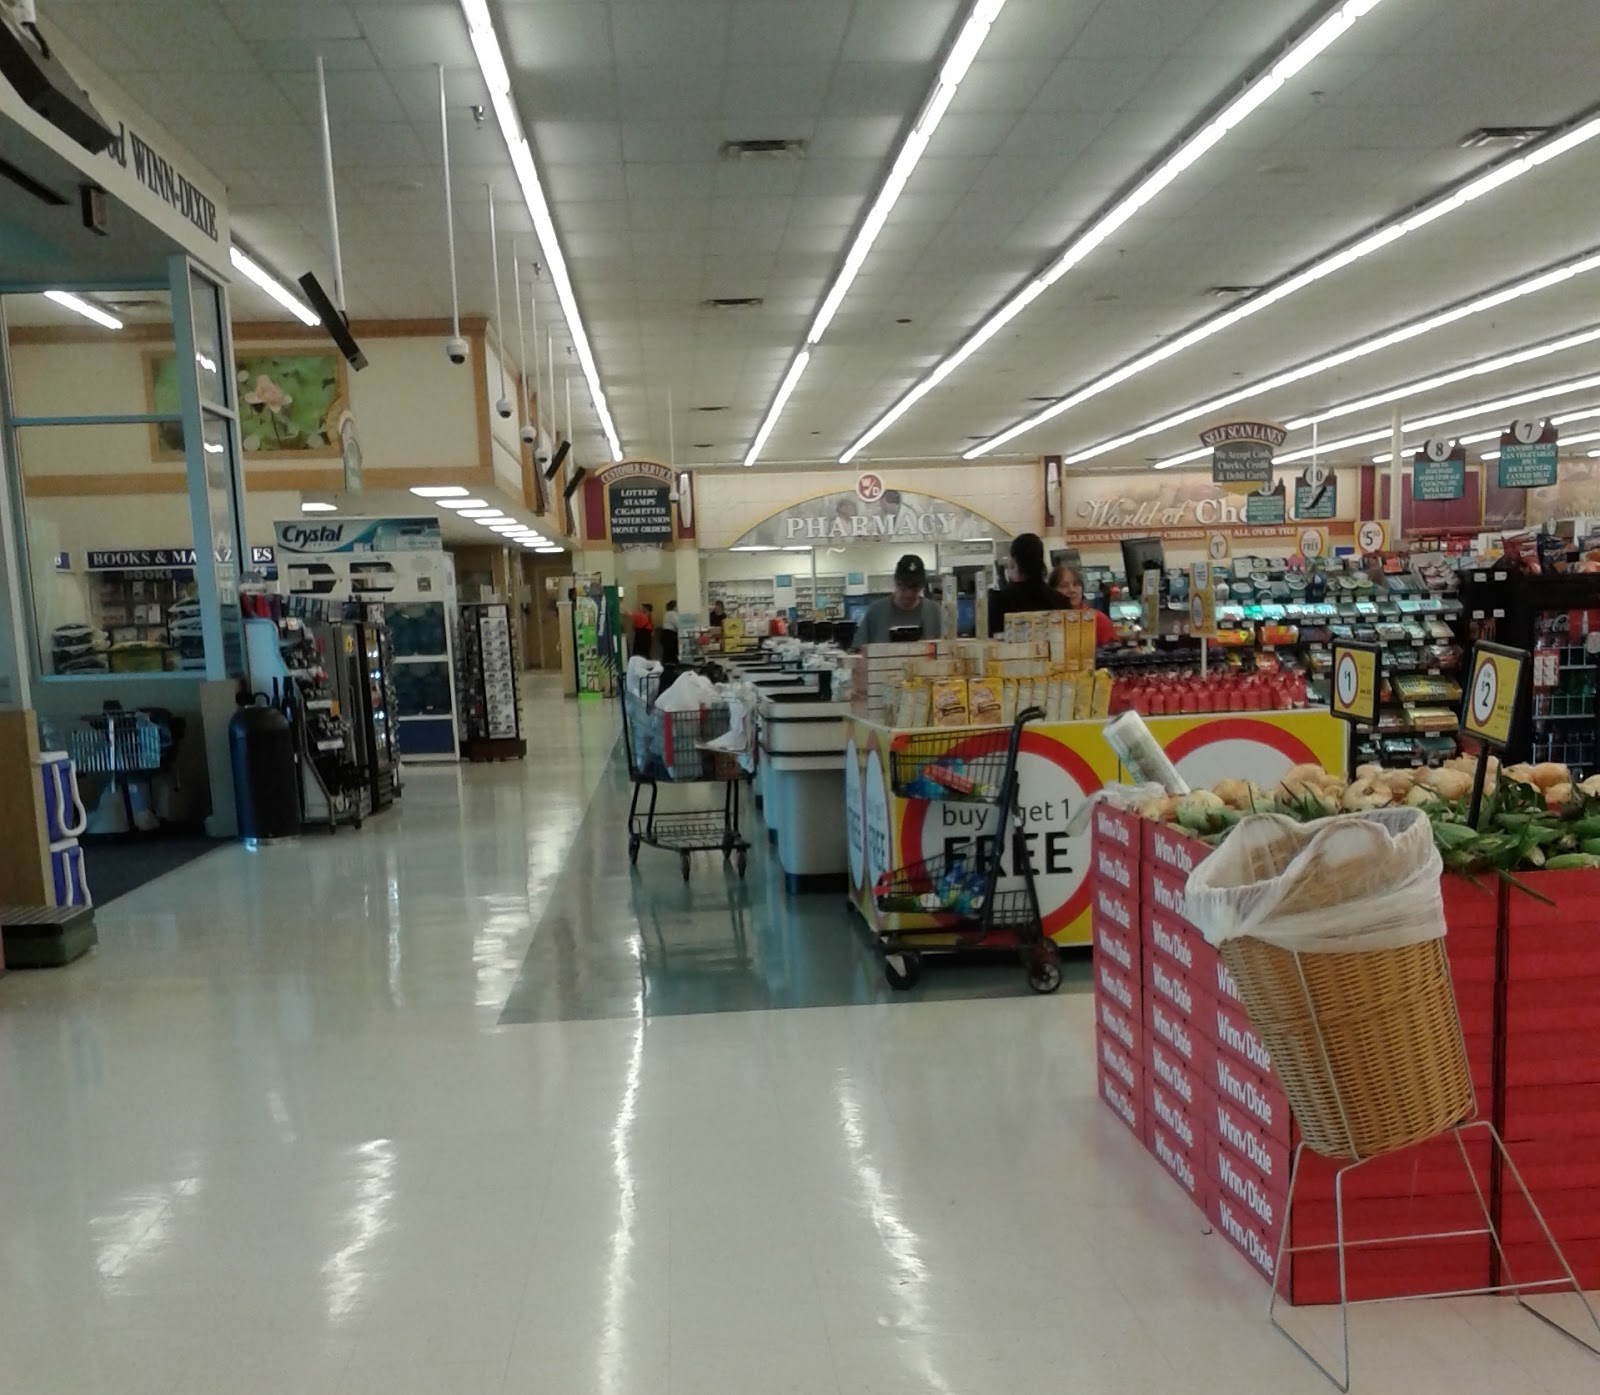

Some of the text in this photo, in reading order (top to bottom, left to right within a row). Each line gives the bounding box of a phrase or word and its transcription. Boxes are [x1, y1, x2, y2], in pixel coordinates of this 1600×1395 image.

[129, 130, 219, 242] WINN-DIXIE
[1203, 424, 1284, 446] SELF SCAN LANES
[1524, 423, 1533, 440] 7
[1435, 441, 1444, 457] 8
[620, 489, 658, 497] LOTTERY
[623, 498, 656, 506] STAMPS
[615, 507, 666, 516] CIGARETTES
[1078, 498, 1155, 528] World
[1161, 499, 1193, 526] of
[611, 516, 671, 524] WESTERN UNION
[785, 510, 957, 539] PHARMACY
[281, 523, 344, 547] Crystal
[612, 526, 671, 534] MONEY ORDERS
[1233, 528, 1251, 537] ALL
[1252, 527, 1276, 536] OVER
[92, 550, 151, 566] BOOKS
[154, 550, 168, 565] &
[942, 803, 989, 832] buy
[1060, 798, 1070, 820] 1
[943, 831, 1073, 878] FREE
